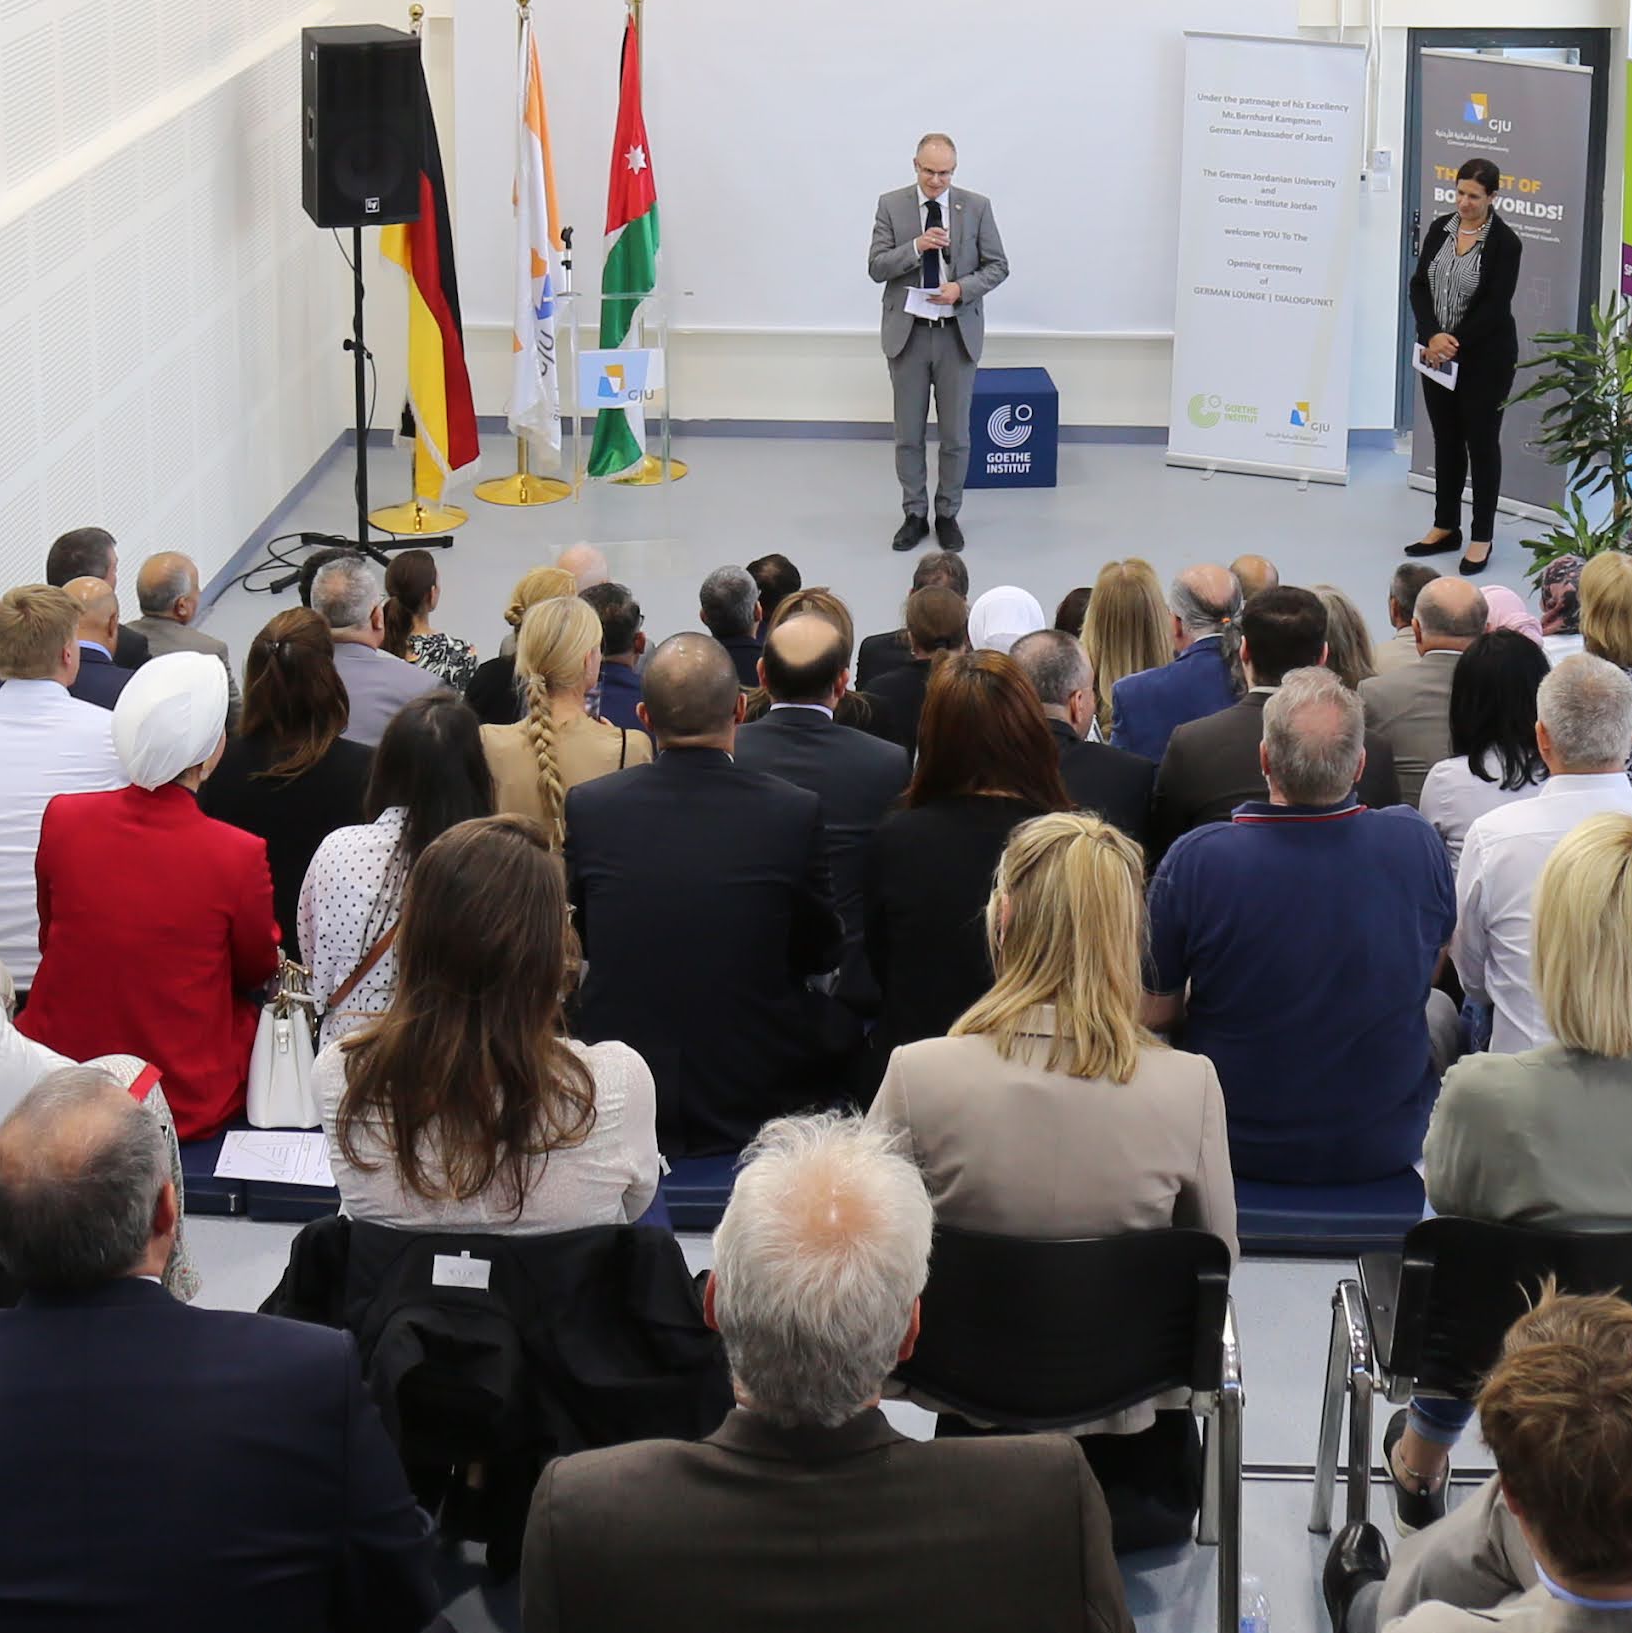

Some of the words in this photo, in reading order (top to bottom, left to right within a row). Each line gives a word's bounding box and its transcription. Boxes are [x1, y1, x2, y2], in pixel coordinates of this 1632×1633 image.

[1197, 93, 1222, 103] Under
[1224, 95, 1237, 104] the
[1239, 97, 1280, 109] patronage
[1282, 100, 1291, 109] of
[1292, 100, 1304, 110] his
[1306, 101, 1349, 113] Excellency
[1275, 116, 1322, 127] Kampmann
[1488, 119, 1512, 134] GJU
[1209, 125, 1242, 136] German
[1243, 128, 1294, 140] Ambassador
[1294, 132, 1304, 141] of
[1305, 133, 1334, 143] Jordan
[1203, 169, 1217, 178] The
[1219, 170, 1251, 180] German
[1253, 173, 1293, 184] Jordanian
[1294, 177, 1336, 189] University
[1434, 165, 1458, 181] TH
[1519, 178, 1543, 193] OF
[1261, 187, 1276, 195] and
[1434, 187, 1457, 204] BO
[1218, 195, 1247, 205] Goethe
[1254, 198, 1288, 209] Institute
[1290, 201, 1318, 211] Jordan
[1224, 227, 1260, 238] welcome
[1262, 230, 1281, 240] YOU
[1282, 231, 1292, 241] To
[1293, 233, 1309, 242] The
[1227, 258, 1261, 270] Opening
[1263, 263, 1303, 274] ceremony
[1259, 277, 1269, 285] of
[1193, 286, 1231, 298] GERMAN
[1232, 290, 1266, 301] LOUNGE
[1274, 294, 1334, 308] DIALOGPUNKT
[627, 389, 655, 403] GJU
[1310, 422, 1331, 434] GJU
[987, 452, 1031, 463] GOETHE
[987, 463, 1031, 474] INSTITUT
